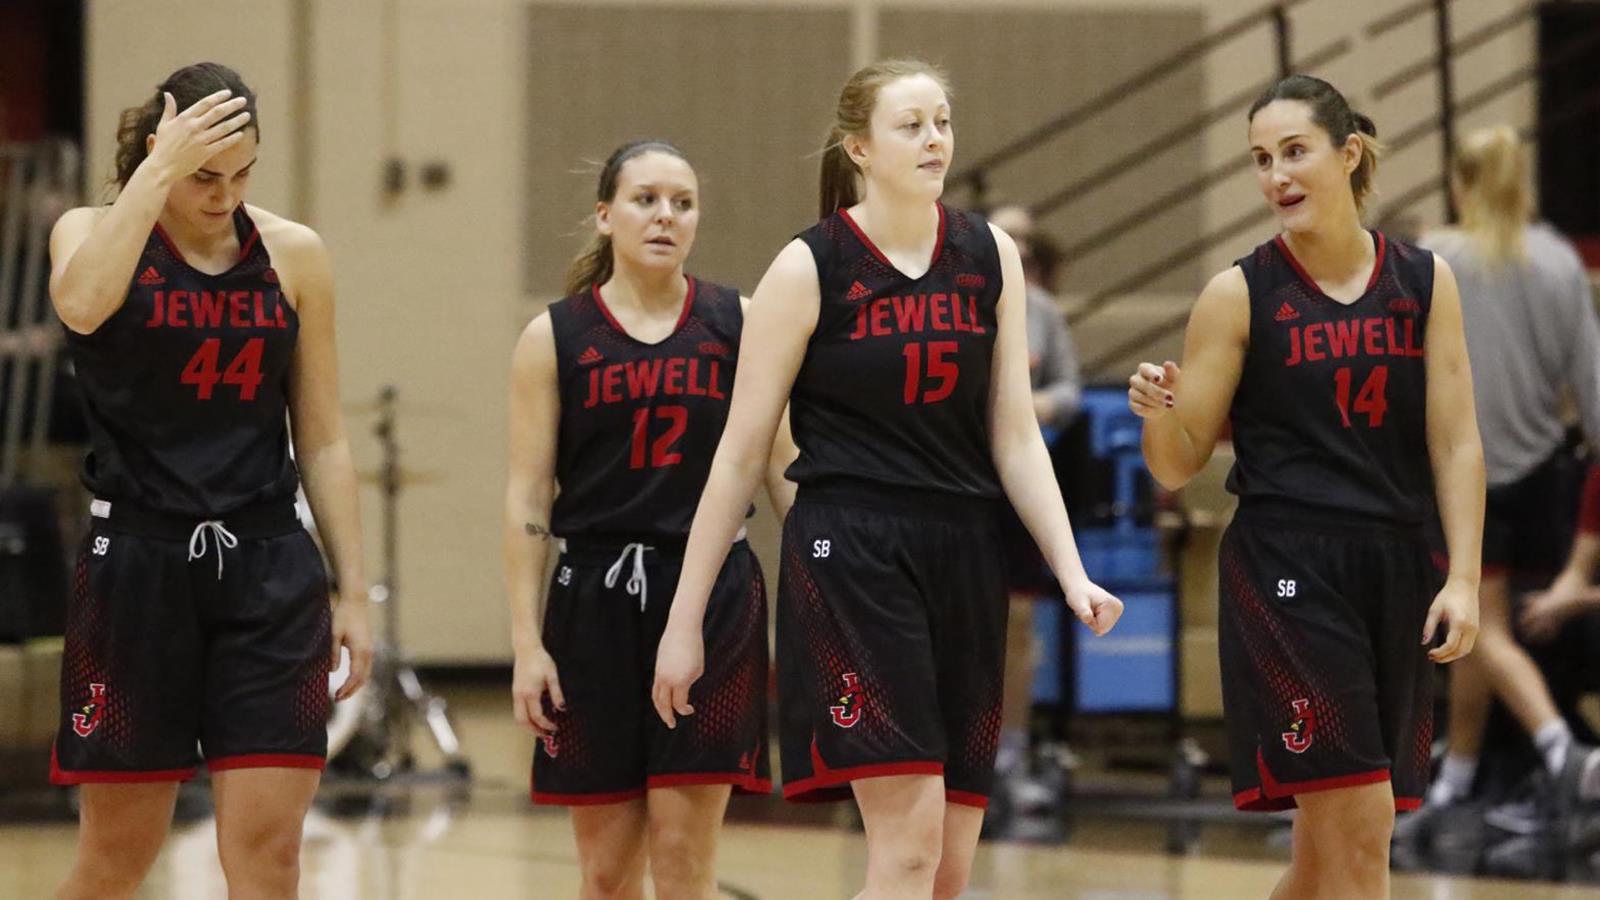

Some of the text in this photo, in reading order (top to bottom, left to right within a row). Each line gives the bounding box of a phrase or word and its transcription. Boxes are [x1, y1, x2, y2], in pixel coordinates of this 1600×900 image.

[850, 293, 986, 340] JEWELL
[1286, 317, 1425, 366] JEWELL
[180, 338, 265, 400] 44
[584, 357, 725, 408] JEWELL
[903, 341, 959, 404] 15
[1334, 365, 1388, 428] 14
[629, 405, 689, 469] 12
[92, 536, 110, 556] SB
[813, 540, 831, 558] SB
[1277, 579, 1296, 597] SB
